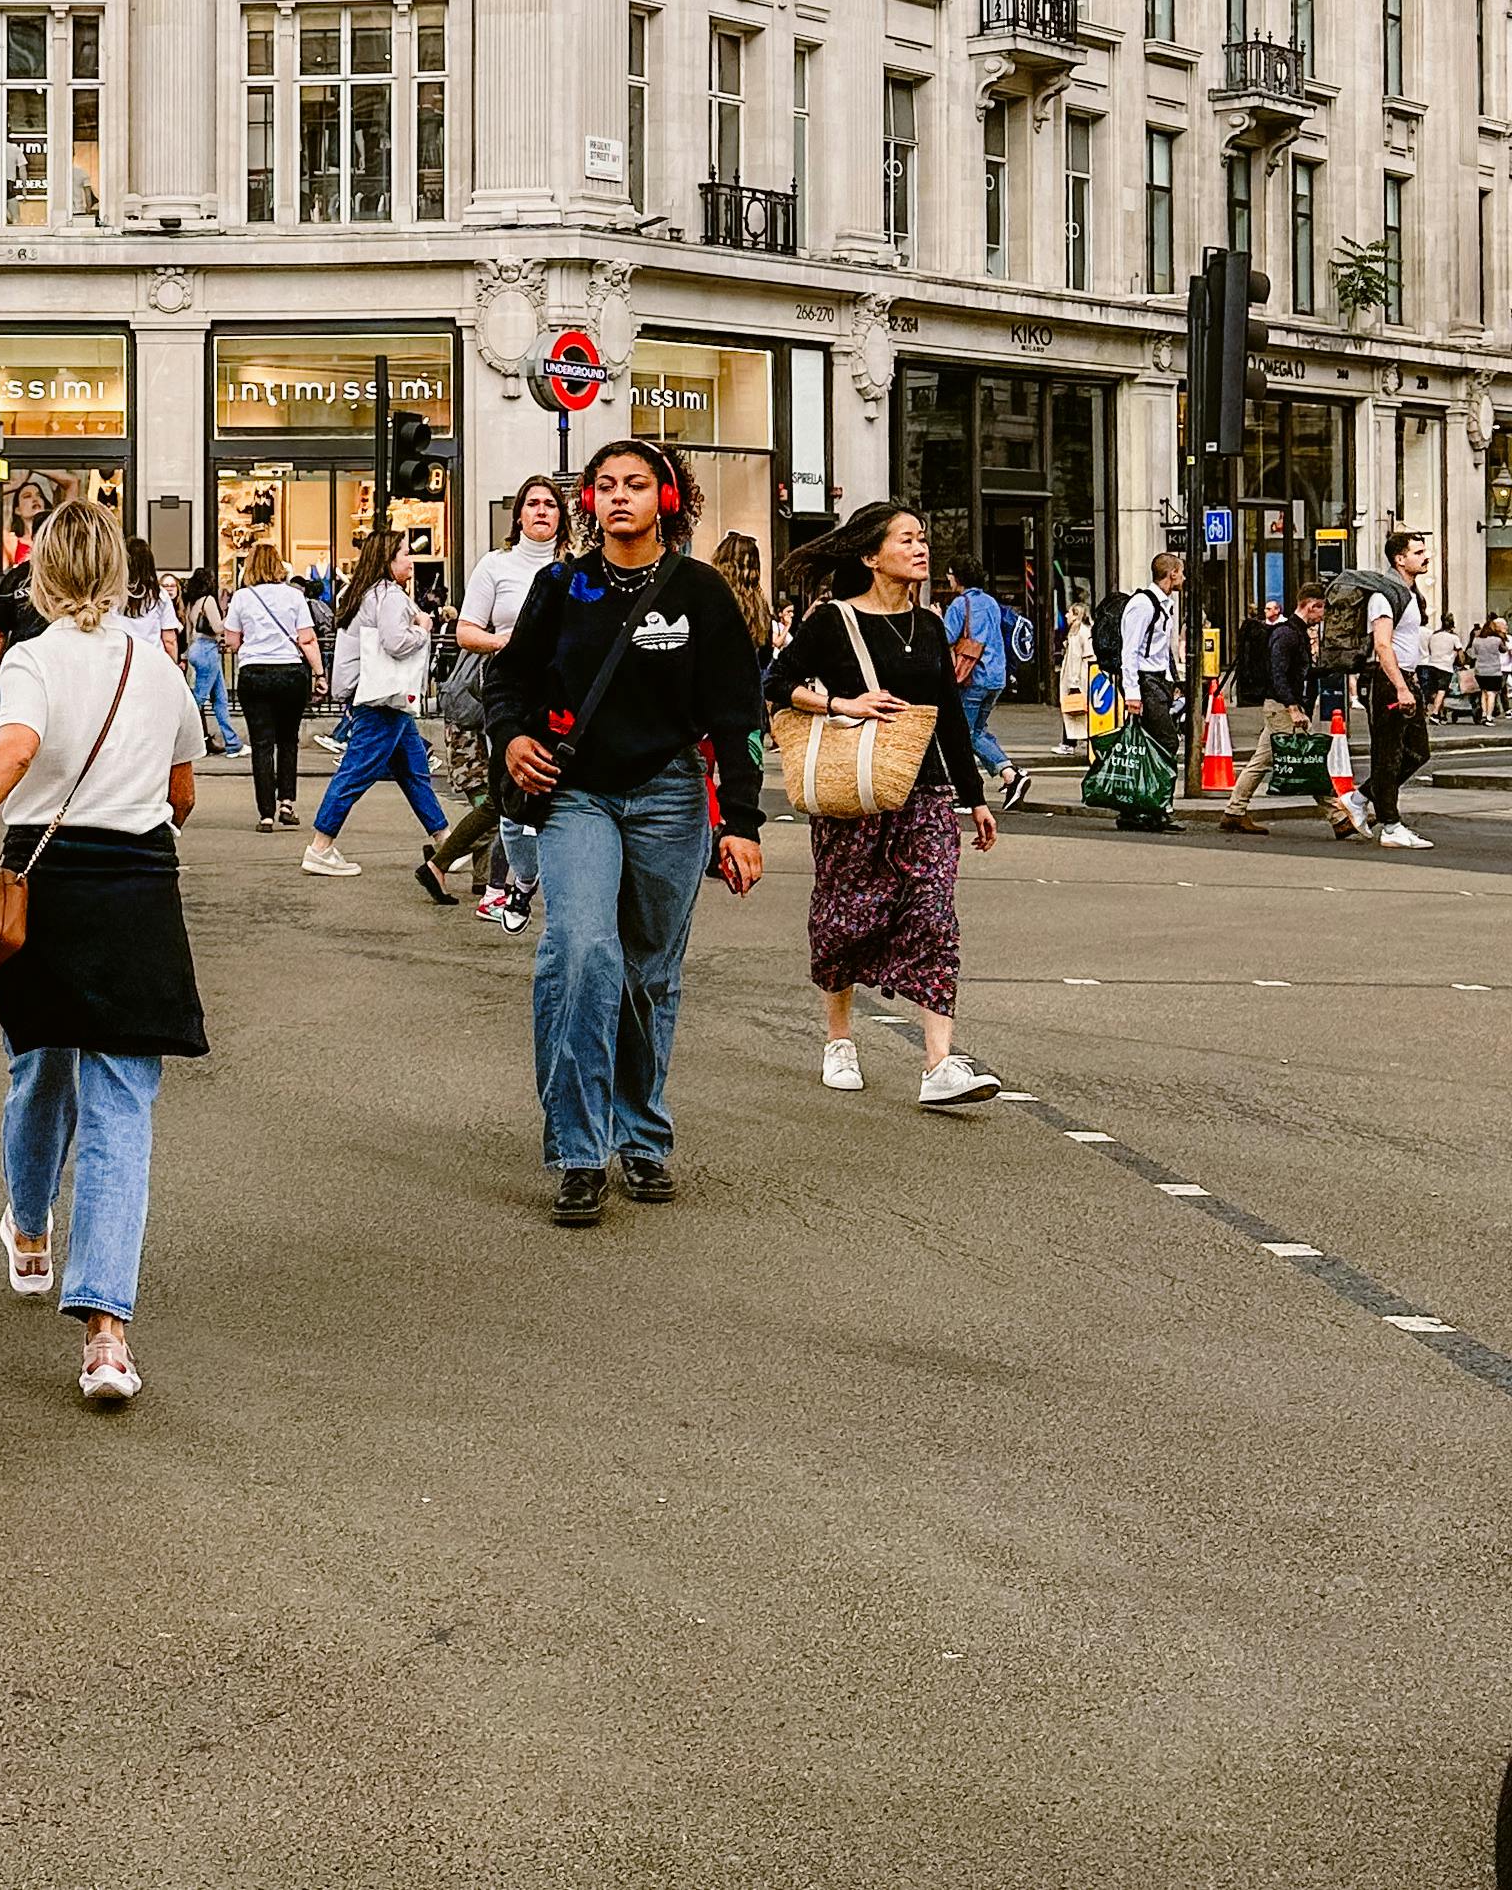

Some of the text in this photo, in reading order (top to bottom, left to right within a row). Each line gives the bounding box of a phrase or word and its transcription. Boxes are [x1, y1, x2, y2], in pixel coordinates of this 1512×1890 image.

[795, 304, 834, 323] 266-270
[1011, 324, 1053, 347] KIKO
[545, 362, 606, 380] UNDERGROUND
[791, 471, 824, 486] SPIRELLA
[1124, 744, 1147, 756] you
